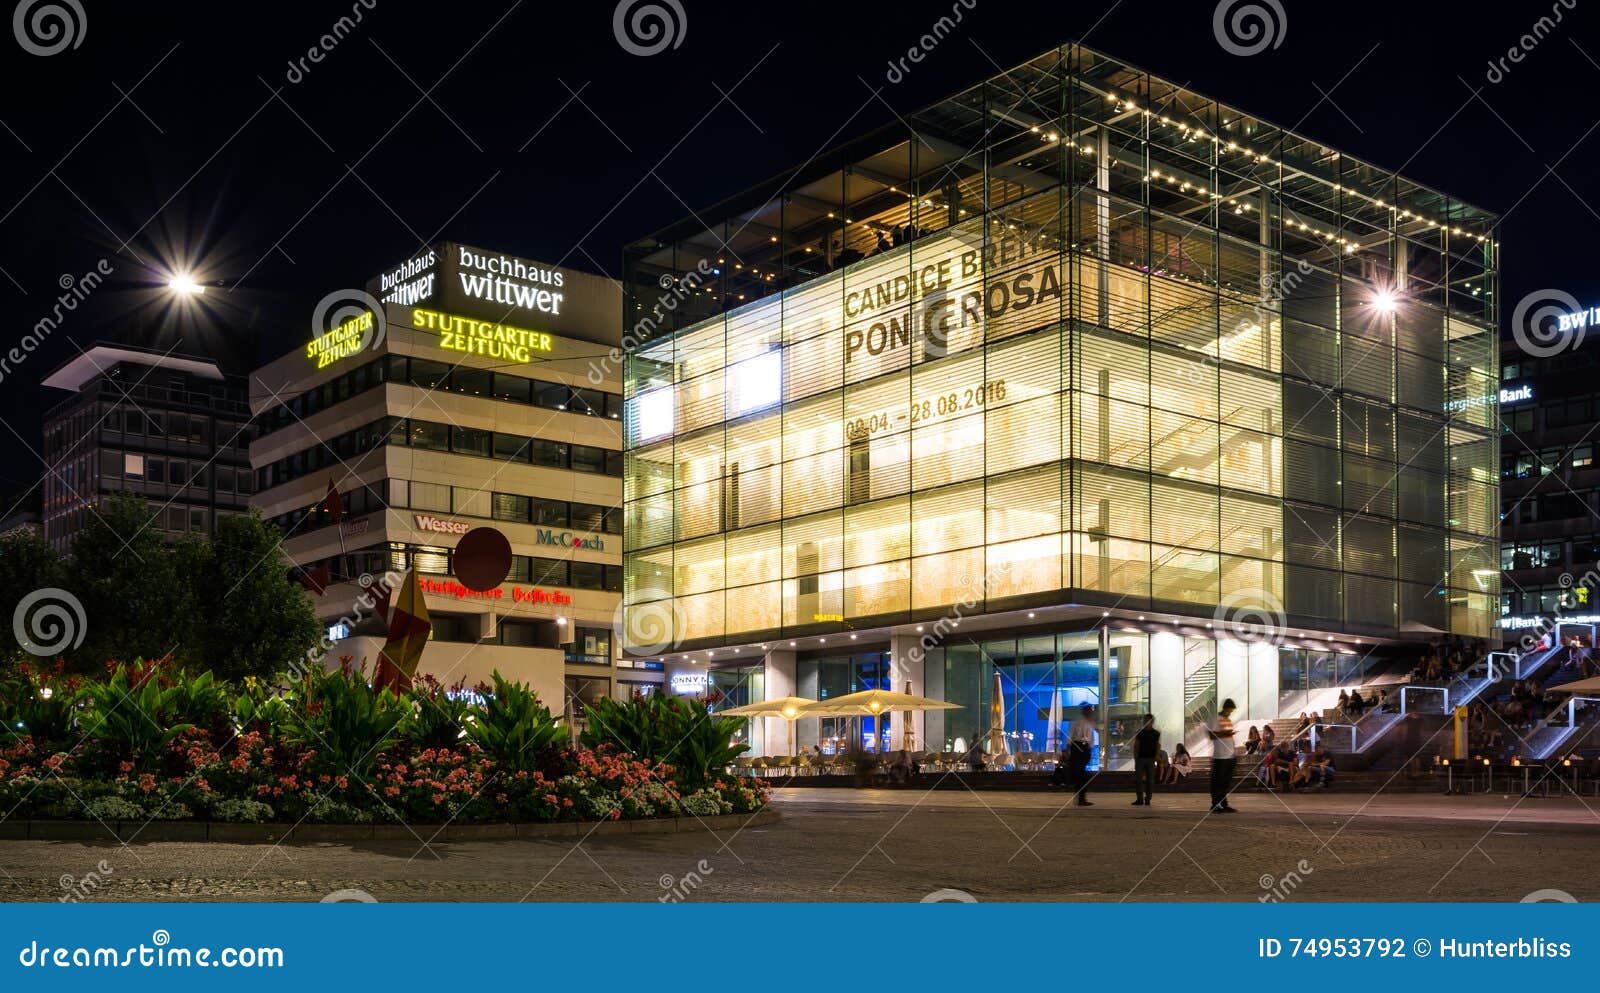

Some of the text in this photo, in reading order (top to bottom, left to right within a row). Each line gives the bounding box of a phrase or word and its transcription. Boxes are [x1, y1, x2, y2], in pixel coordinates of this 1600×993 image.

[381, 250, 435, 291] buchhaus
[460, 247, 563, 287] buchhaus
[459, 272, 563, 315] wittwer
[845, 258, 952, 319] CANDICE
[307, 311, 373, 359] STUTTGARTER
[413, 309, 551, 351] STUTTGARTER
[440, 330, 530, 363] ZEITUNG
[318, 336, 361, 369] ZEITUNG
[911, 378, 1007, 424] 28.08.2016
[1500, 385, 1533, 403] Bank
[414, 514, 469, 535] Wesser
[536, 527, 605, 552] McCoach
